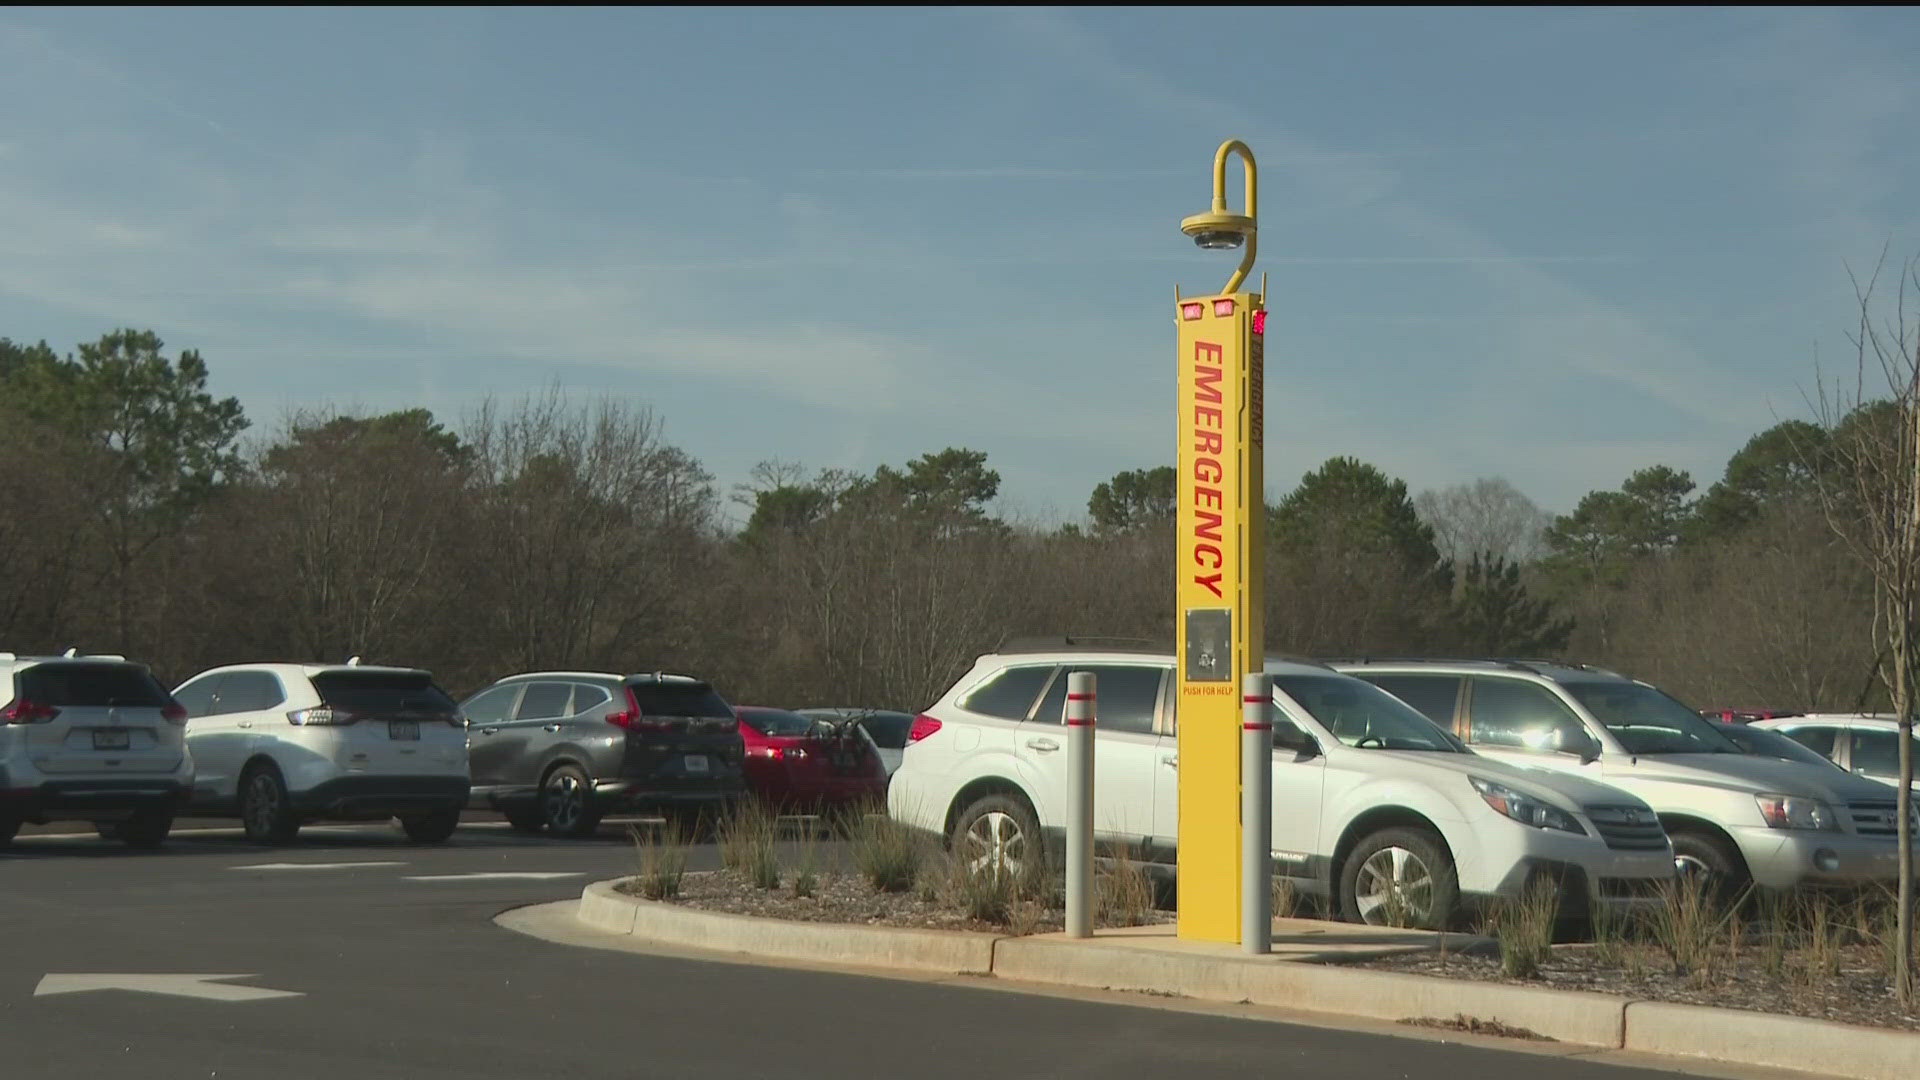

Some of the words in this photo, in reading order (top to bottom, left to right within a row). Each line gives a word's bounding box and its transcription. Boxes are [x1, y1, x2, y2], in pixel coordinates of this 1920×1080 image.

[1194, 341, 1222, 598] EMERGENCY
[1183, 686, 1201, 696] PUSH
[1203, 686, 1215, 696] FOR
[1217, 686, 1233, 696] HELP
